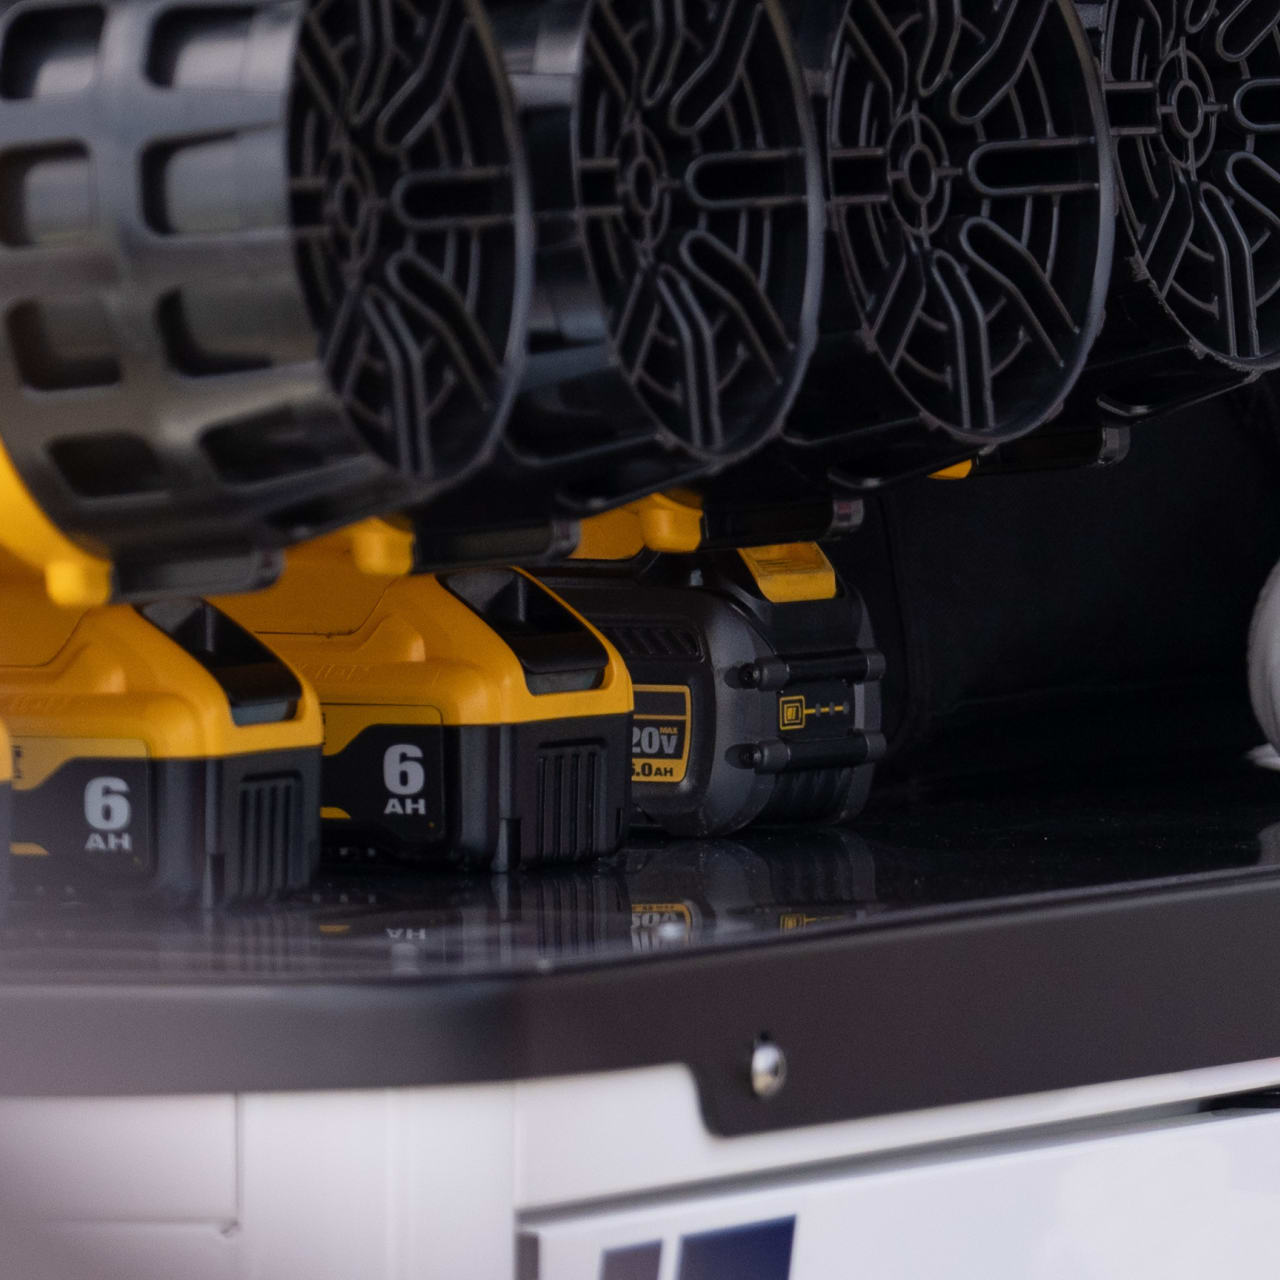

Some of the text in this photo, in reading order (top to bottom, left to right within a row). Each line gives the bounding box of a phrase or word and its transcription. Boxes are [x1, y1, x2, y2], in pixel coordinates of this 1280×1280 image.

[383, 743, 426, 796] 6
[84, 776, 131, 830] 6
[383, 798, 427, 815] AH
[84, 832, 133, 852] AH
